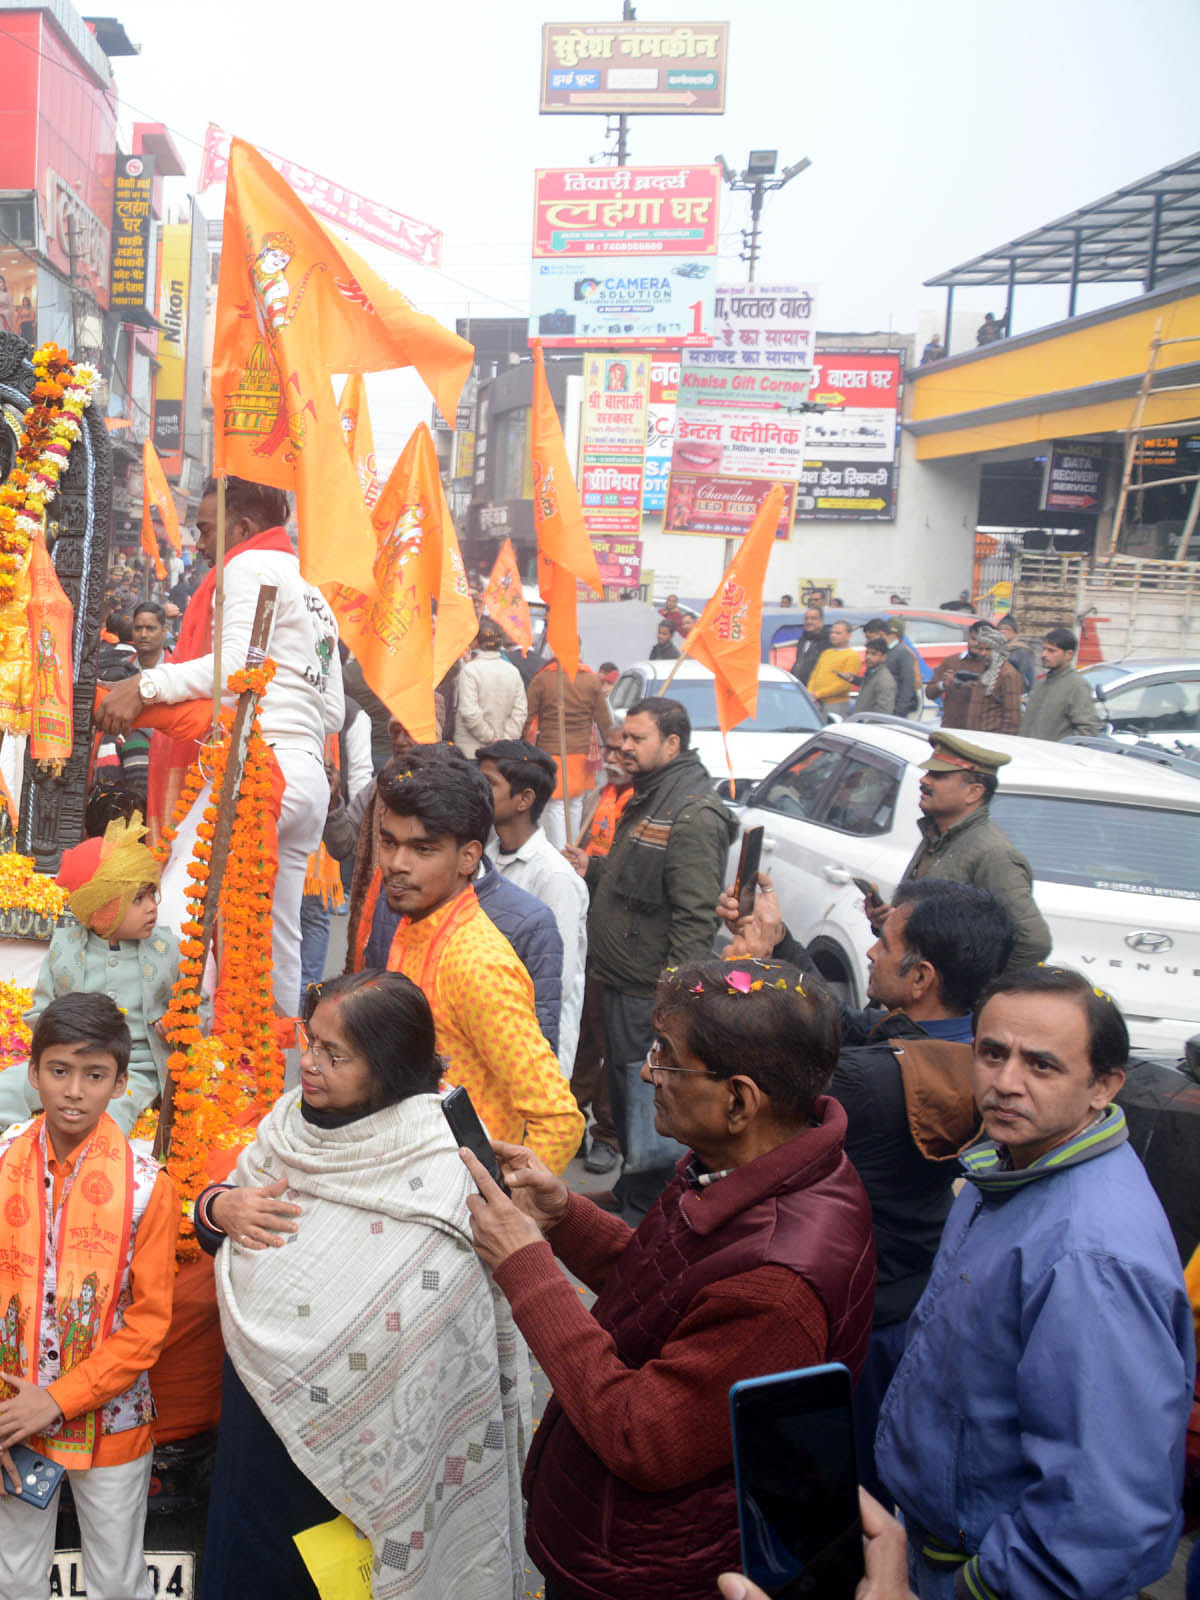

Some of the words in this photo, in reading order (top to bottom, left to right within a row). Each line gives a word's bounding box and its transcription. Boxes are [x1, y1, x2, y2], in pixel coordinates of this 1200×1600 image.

[618, 27, 719, 60] नमकीन
[670, 197, 713, 225] घर
[605, 276, 673, 291] CAMERA
[599, 289, 674, 300] SOLUTION
[164, 279, 184, 344] Nikon
[780, 290, 814, 319] वाले
[763, 329, 809, 346] सामान
[764, 350, 807, 365] सामान
[682, 373, 729, 390] Khalsa
[731, 375, 757, 391] Gift
[760, 376, 810, 394] Corner
[603, 391, 644, 410] बालाजी
[1063, 456, 1093, 469] DATA
[1052, 469, 1099, 482] RECOVERY
[1052, 482, 1097, 494] SERVICE
[697, 501, 723, 512] LED
